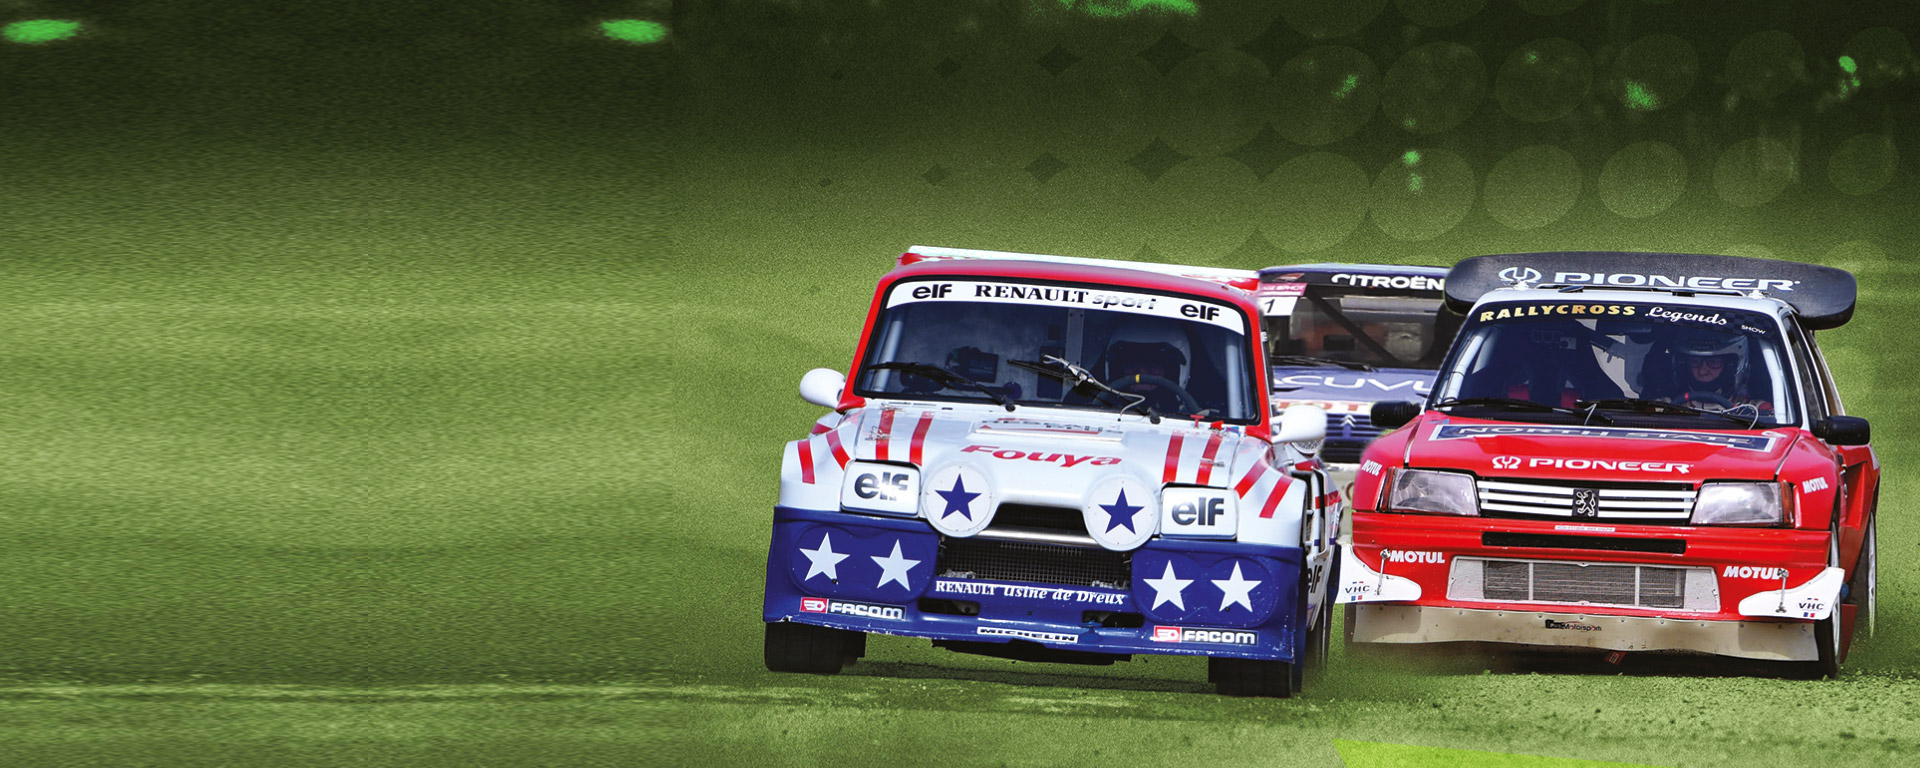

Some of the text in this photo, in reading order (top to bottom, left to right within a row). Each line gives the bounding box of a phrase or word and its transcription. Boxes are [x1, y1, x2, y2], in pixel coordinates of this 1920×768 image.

[1331, 274, 1444, 290] CITROËN
[1554, 272, 1800, 292] PIONEER
[912, 284, 1220, 321] elf RENAULT sport elf
[1264, 298, 1276, 314] 1
[1480, 305, 1766, 335] RALLYCROSS Legends SHOW
[961, 444, 1122, 468] Fouya
[1361, 459, 1383, 476] MOTUL
[1529, 458, 1693, 474] PIONEER
[854, 471, 909, 501] elf
[1802, 477, 1828, 494] MOTUL
[1171, 497, 1225, 527] elf
[1390, 550, 1445, 564] MOTUL
[1723, 565, 1782, 580] MOTUL
[935, 580, 997, 596] RENAULT
[1051, 587, 1074, 602] de
[1077, 591, 1128, 606] Dreux
[1345, 585, 1370, 594] VHC
[830, 601, 903, 619] FACOM
[1798, 602, 1824, 611] VHC
[981, 628, 1076, 642] MICHELIN
[1184, 630, 1255, 645] FACOM
